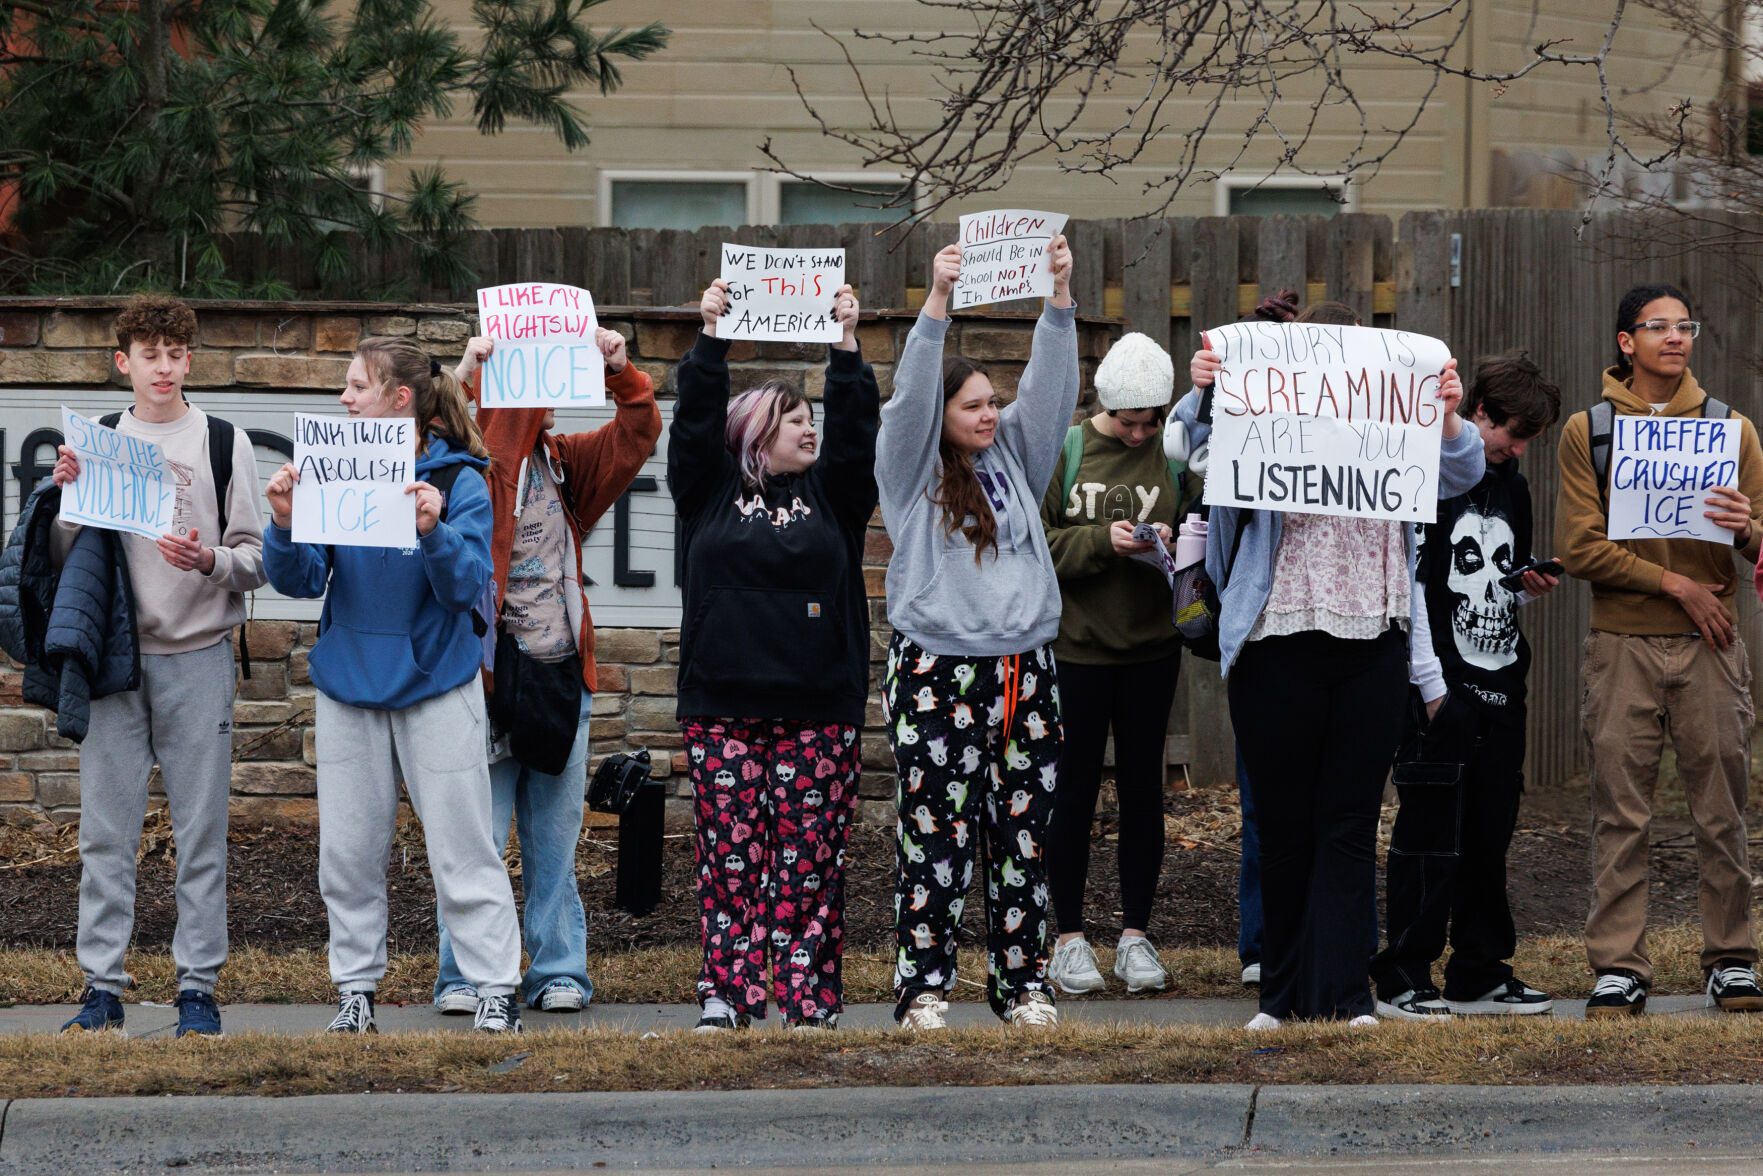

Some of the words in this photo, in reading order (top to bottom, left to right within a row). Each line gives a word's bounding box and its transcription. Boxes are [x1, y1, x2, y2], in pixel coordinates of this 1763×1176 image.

[965, 214, 1045, 244] Children
[725, 250, 756, 270] WE
[997, 264, 1037, 282] NOT!
[482, 291, 487, 308] I
[498, 285, 544, 307] LIKE
[549, 287, 579, 310] MY
[1216, 322, 1346, 365] HISTORY
[1380, 331, 1416, 367] IS
[483, 347, 526, 403] NO
[535, 345, 591, 400] ICE
[1219, 367, 1440, 428] SCREAMING
[71, 414, 120, 459] STOP
[126, 436, 163, 467] THE
[296, 416, 346, 447] HONK
[347, 421, 407, 445] TWICE
[1241, 417, 1313, 455] ARE
[1347, 422, 1406, 461] YOU
[1616, 419, 1626, 451] I
[1634, 419, 1726, 455] PREFER
[297, 455, 406, 485] ABOLISH
[1232, 459, 1426, 513] LISTENING?
[1614, 456, 1736, 491] CRUSHED
[75, 458, 170, 528] VIOLENCE
[320, 488, 380, 534] ICE
[1065, 482, 1160, 522] STAY
[1645, 493, 1694, 526] ICE
